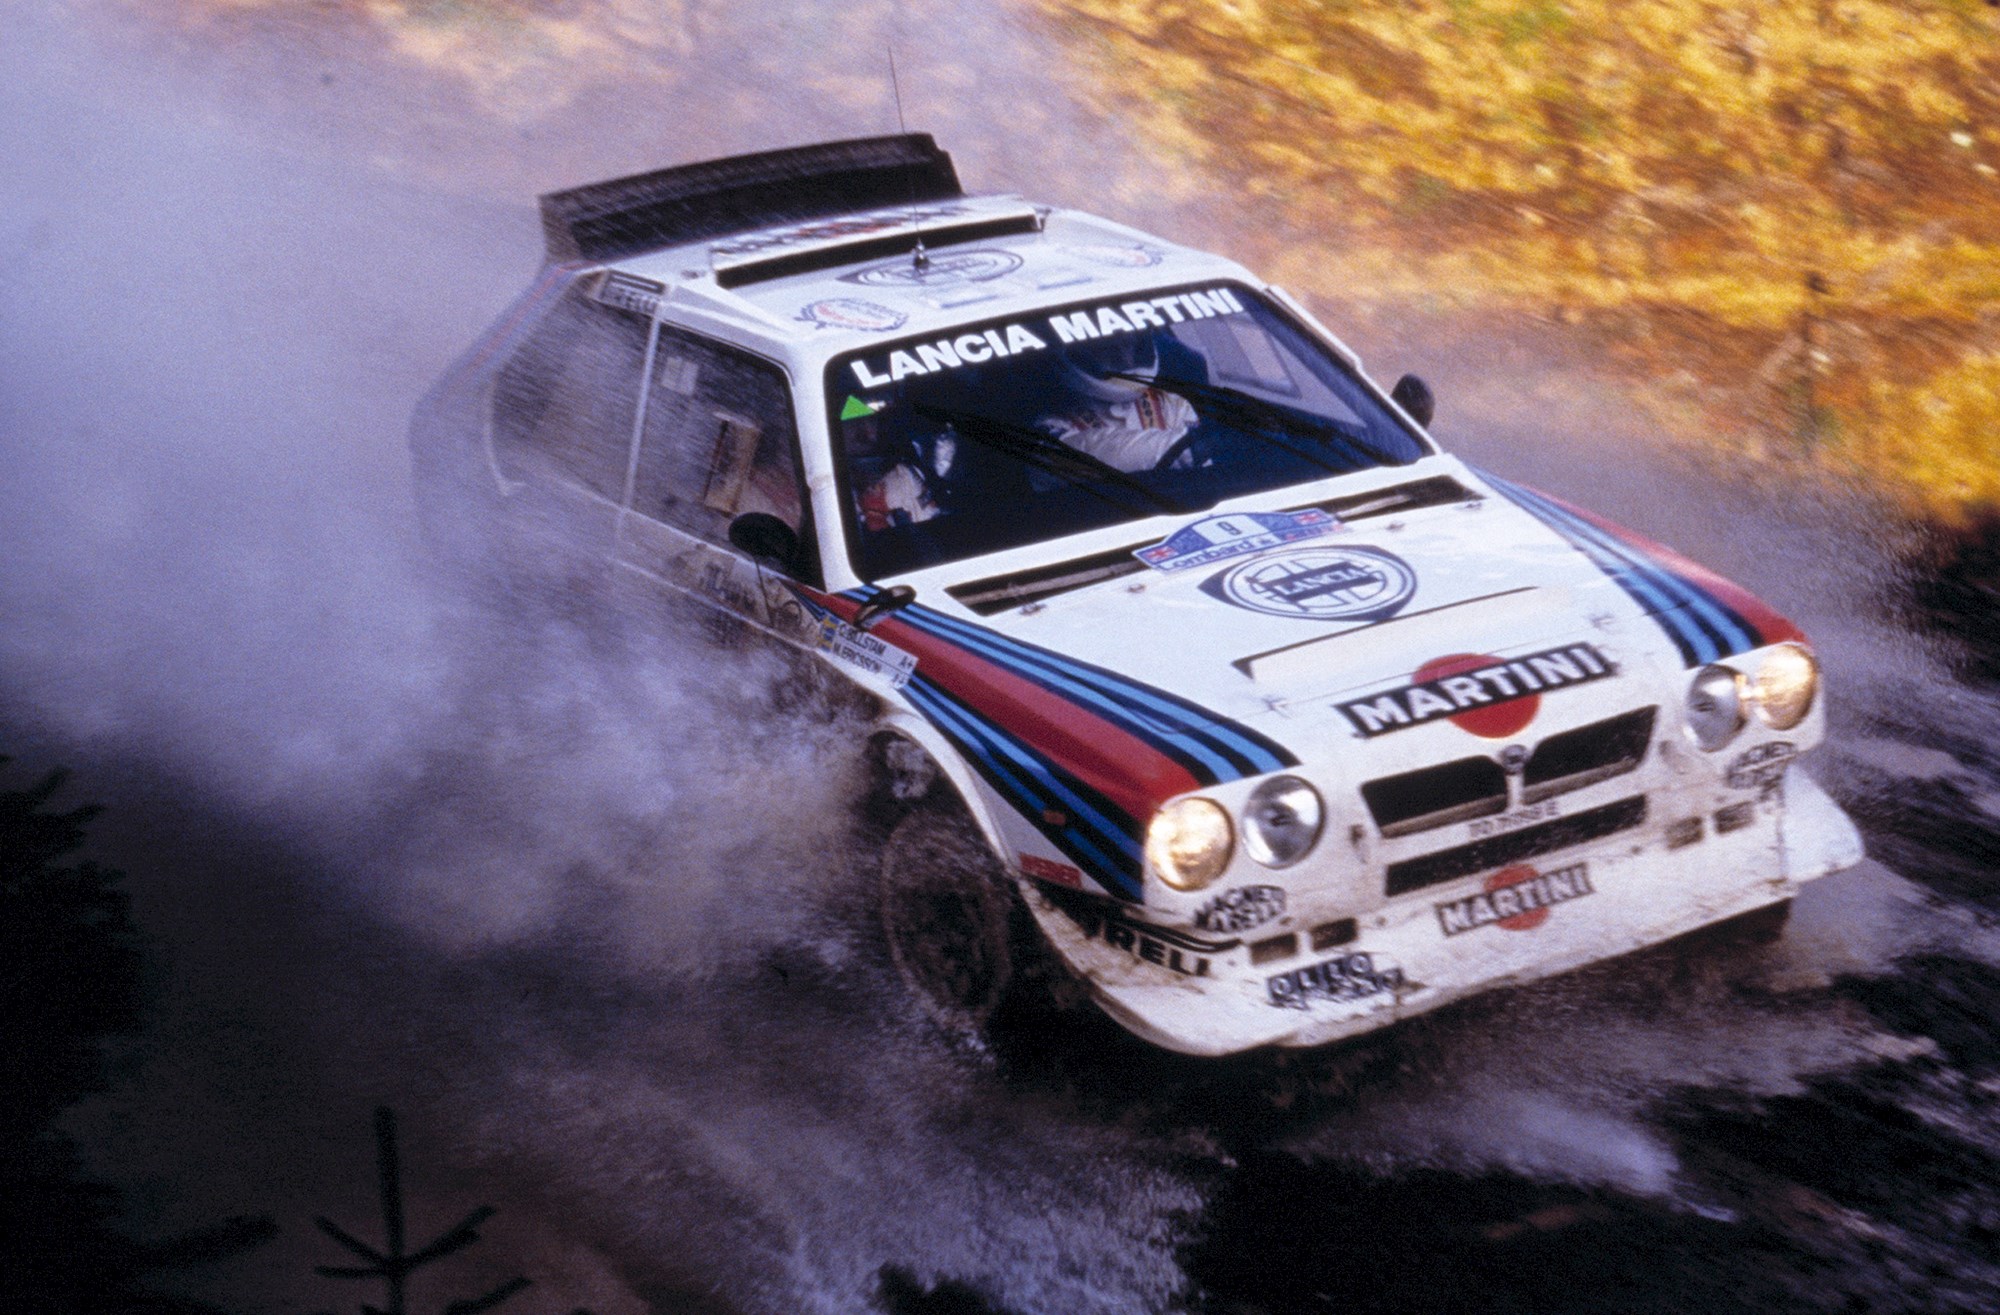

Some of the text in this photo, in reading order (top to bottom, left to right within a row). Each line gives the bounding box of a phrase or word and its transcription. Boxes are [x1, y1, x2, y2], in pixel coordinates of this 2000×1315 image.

[850, 288, 1244, 389] LANCIA MARTINI
[1217, 521, 1242, 536] 9
[1351, 648, 1605, 732] MARTINI
[1440, 865, 1590, 934] MARTINI
